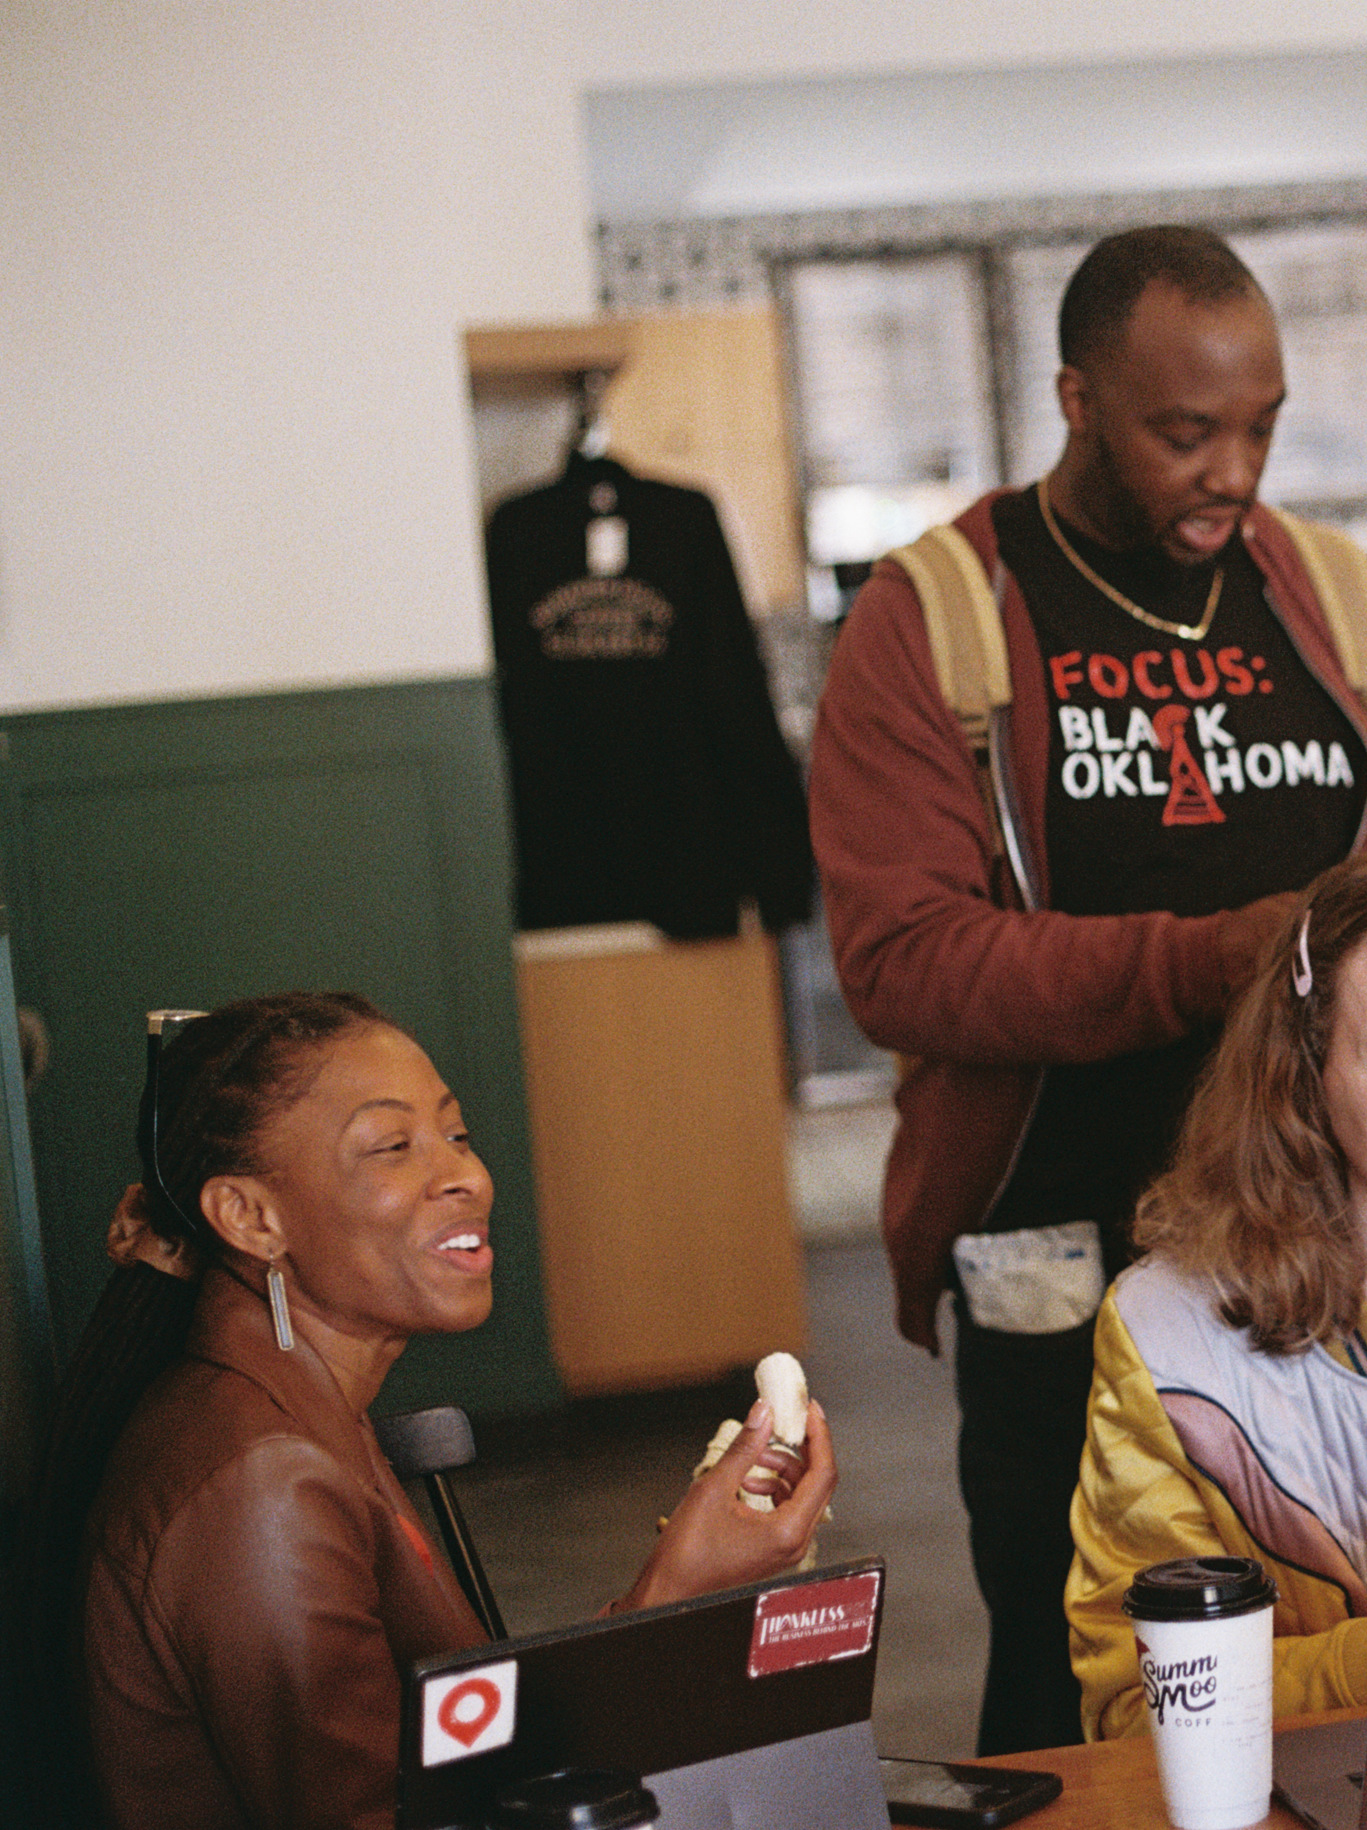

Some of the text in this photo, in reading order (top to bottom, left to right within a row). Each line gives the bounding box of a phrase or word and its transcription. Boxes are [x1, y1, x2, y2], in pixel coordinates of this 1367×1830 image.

[1050, 646, 1274, 699] FOCUS:
[1058, 703, 1236, 752] BLACK
[1061, 739, 1354, 826] OKLAHOMA
[1143, 1654, 1217, 1709] Summ
